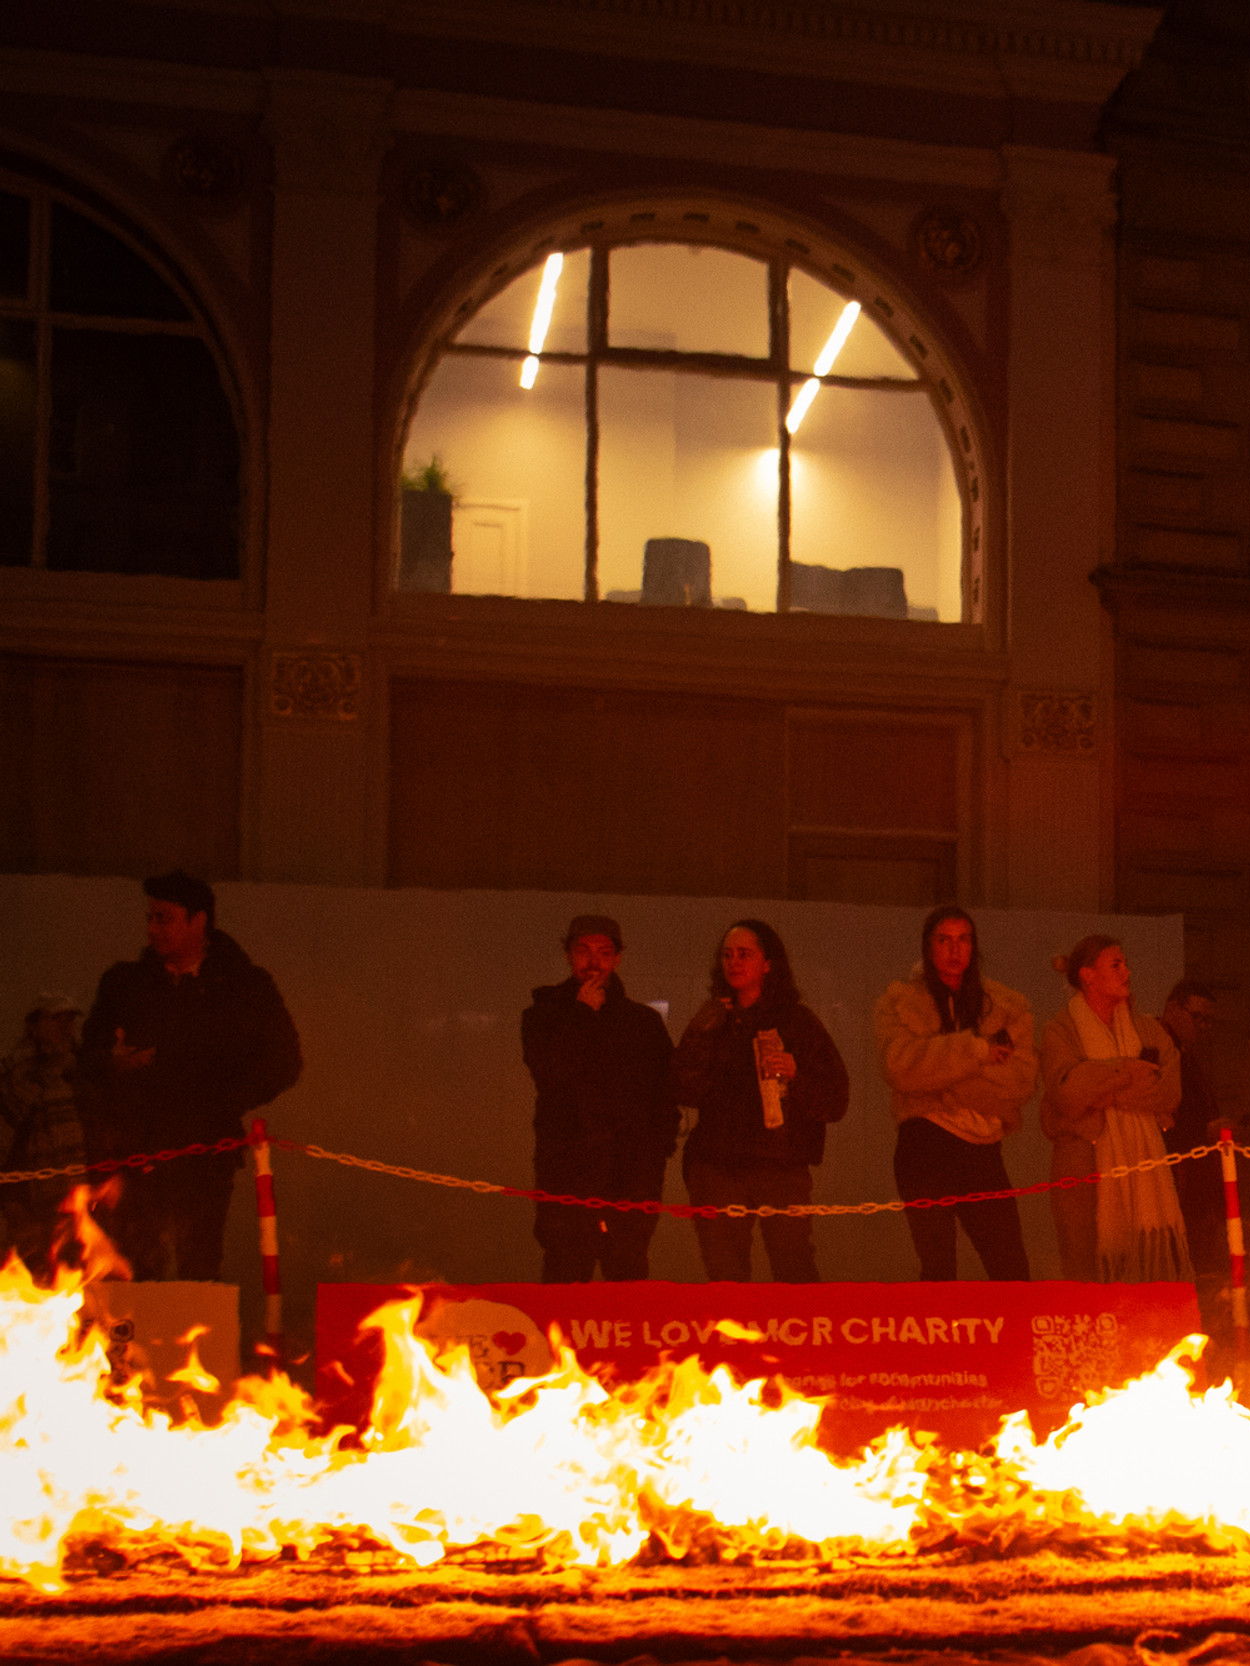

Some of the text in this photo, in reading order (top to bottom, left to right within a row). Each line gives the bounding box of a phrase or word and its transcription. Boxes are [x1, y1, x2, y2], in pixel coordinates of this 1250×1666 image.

[571, 1319, 632, 1349] WE
[747, 1316, 832, 1346] MCR
[841, 1316, 1004, 1345] CHARITY
[840, 1372, 866, 1387] for
